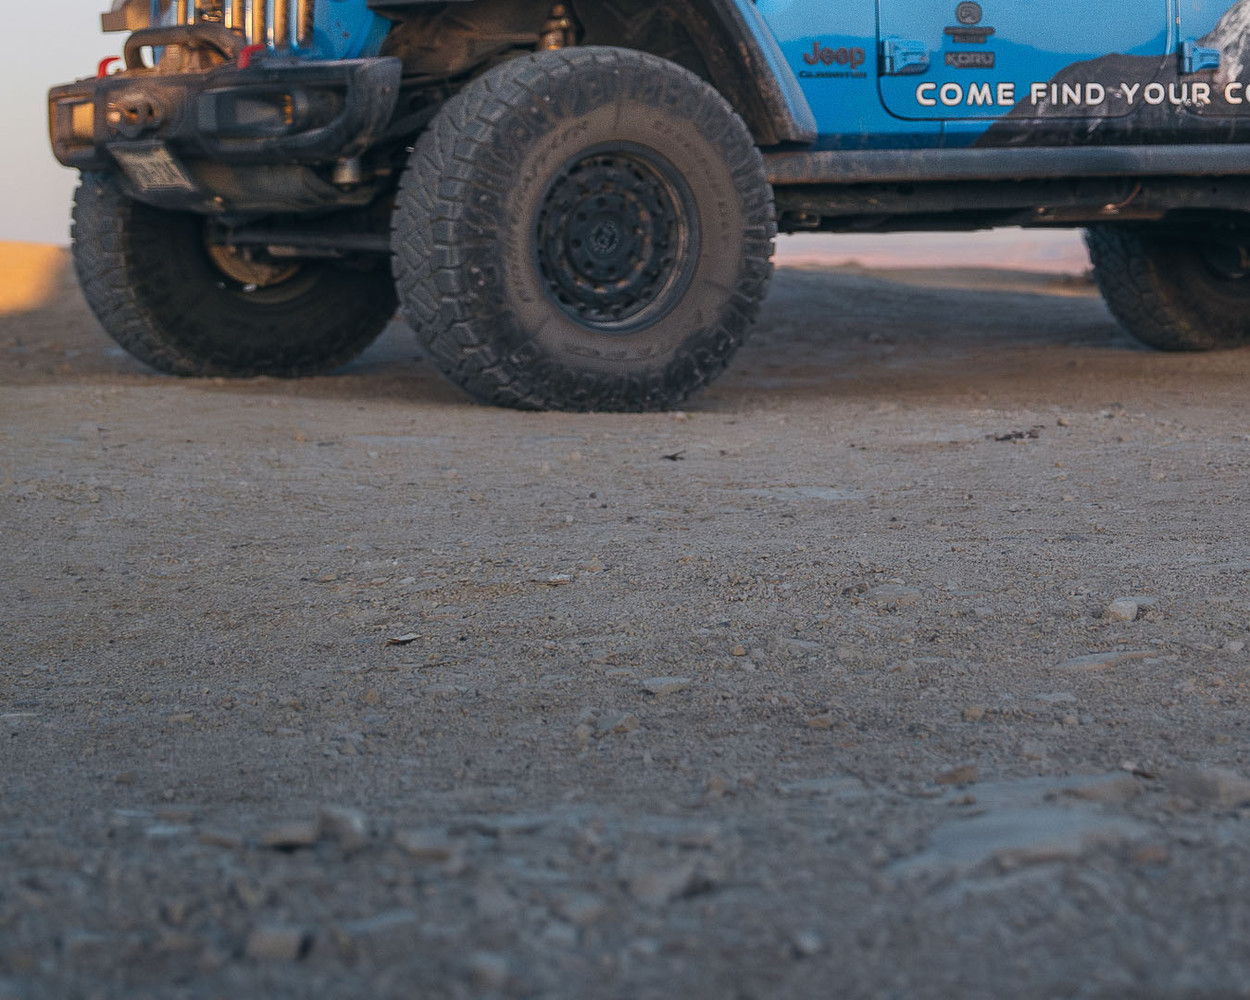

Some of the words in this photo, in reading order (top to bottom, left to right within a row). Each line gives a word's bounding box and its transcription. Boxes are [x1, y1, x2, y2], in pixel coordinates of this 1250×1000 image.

[803, 41, 865, 69] Jeep
[914, 82, 1015, 107] COME
[1030, 82, 1105, 106] FIND
[1120, 81, 1212, 105] YOUR
